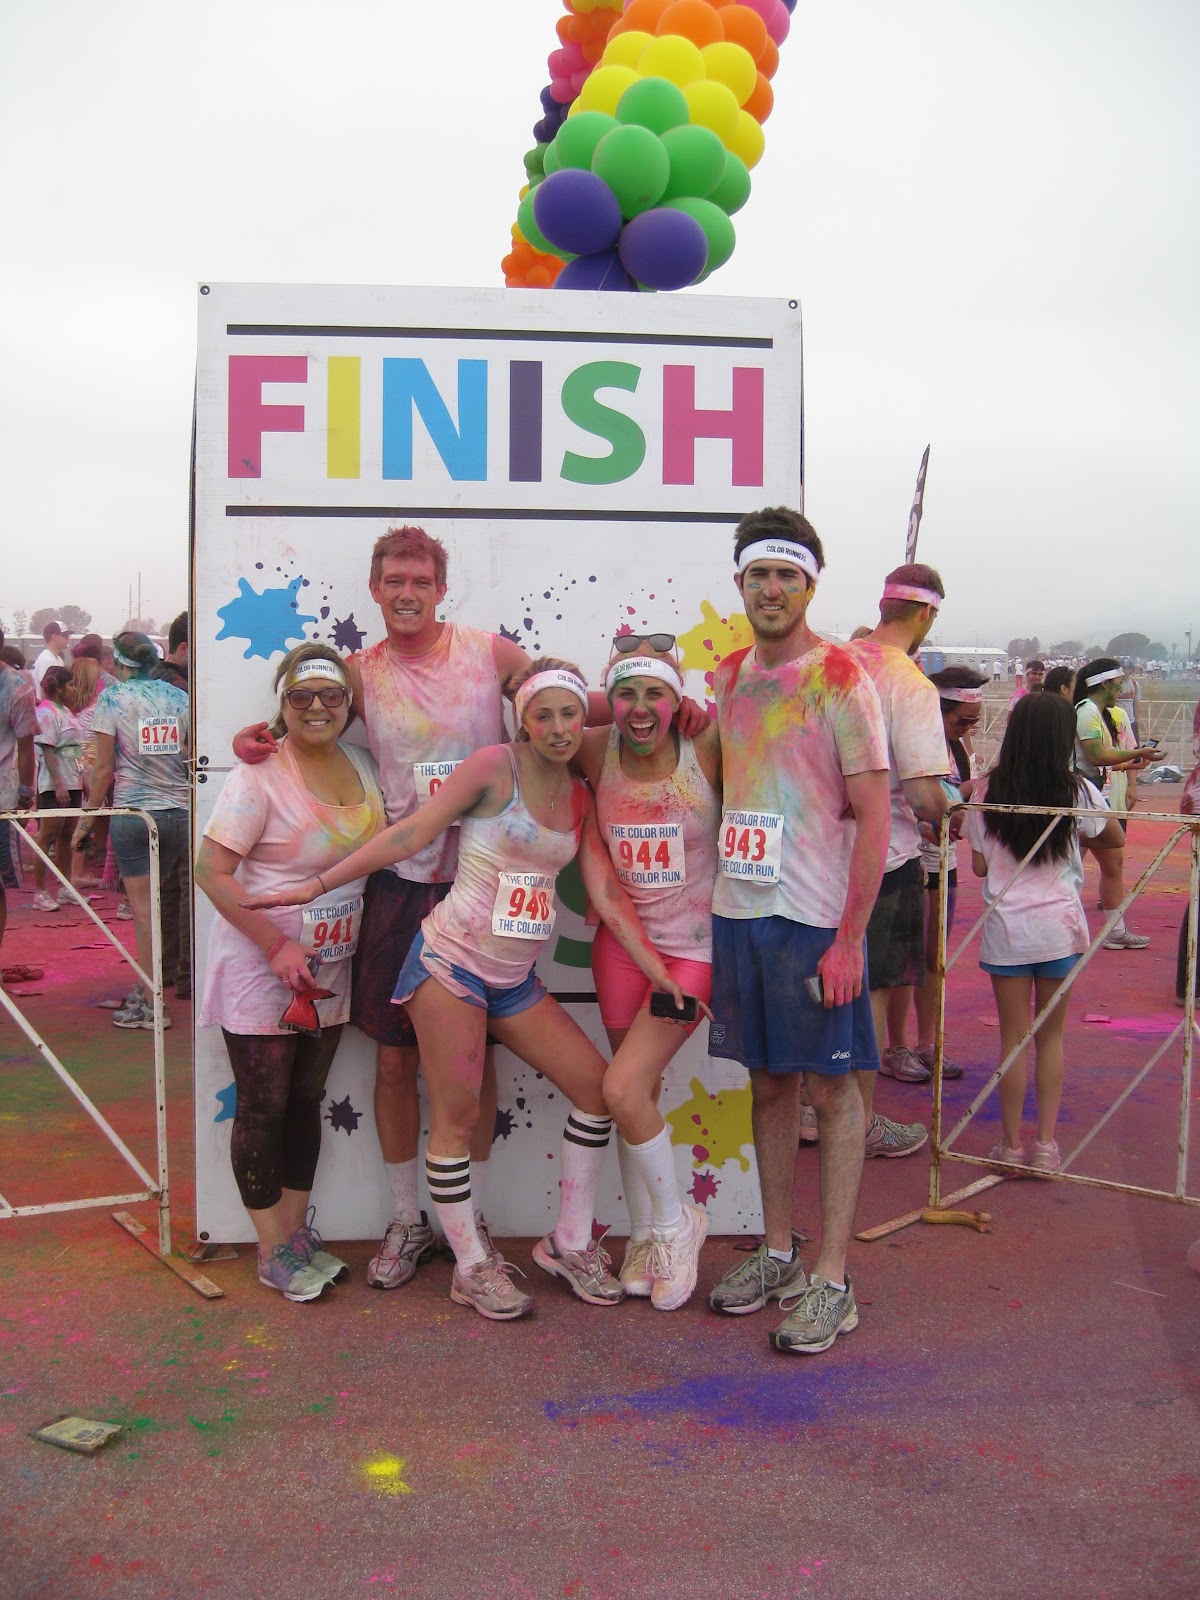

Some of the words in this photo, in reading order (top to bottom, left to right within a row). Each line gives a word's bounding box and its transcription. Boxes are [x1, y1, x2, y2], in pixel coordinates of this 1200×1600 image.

[228, 355, 764, 487] FINISH
[766, 545, 784, 554] COLOR
[295, 664, 310, 674] COLOR
[142, 718, 152, 726] THE
[152, 718, 168, 726] COLOR
[141, 726, 178, 744] 9174
[169, 744, 178, 752] RUN
[420, 764, 437, 776] THE
[726, 812, 736, 824] THE
[736, 813, 759, 826] COLOR
[760, 815, 778, 829] RUN
[611, 826, 626, 838] THE
[628, 827, 657, 838] COLOR
[659, 826, 678, 838] RUN
[724, 826, 767, 861] 943
[619, 840, 671, 870] 944
[616, 868, 630, 881] THE
[631, 871, 660, 883] COLOR
[661, 871, 680, 882] RUN
[730, 861, 753, 875] COLOR
[755, 864, 774, 877] RUN
[504, 875, 523, 886] THE
[524, 875, 545, 888] COLOR
[309, 908, 325, 921] THE
[326, 904, 349, 919] COLOR
[349, 897, 361, 912] RUN
[507, 887, 550, 921] 940
[312, 915, 353, 948] 941
[498, 918, 515, 932] THE
[517, 921, 541, 935] COLOR
[541, 923, 552, 935] RUN
[320, 946, 344, 959] COLOR
